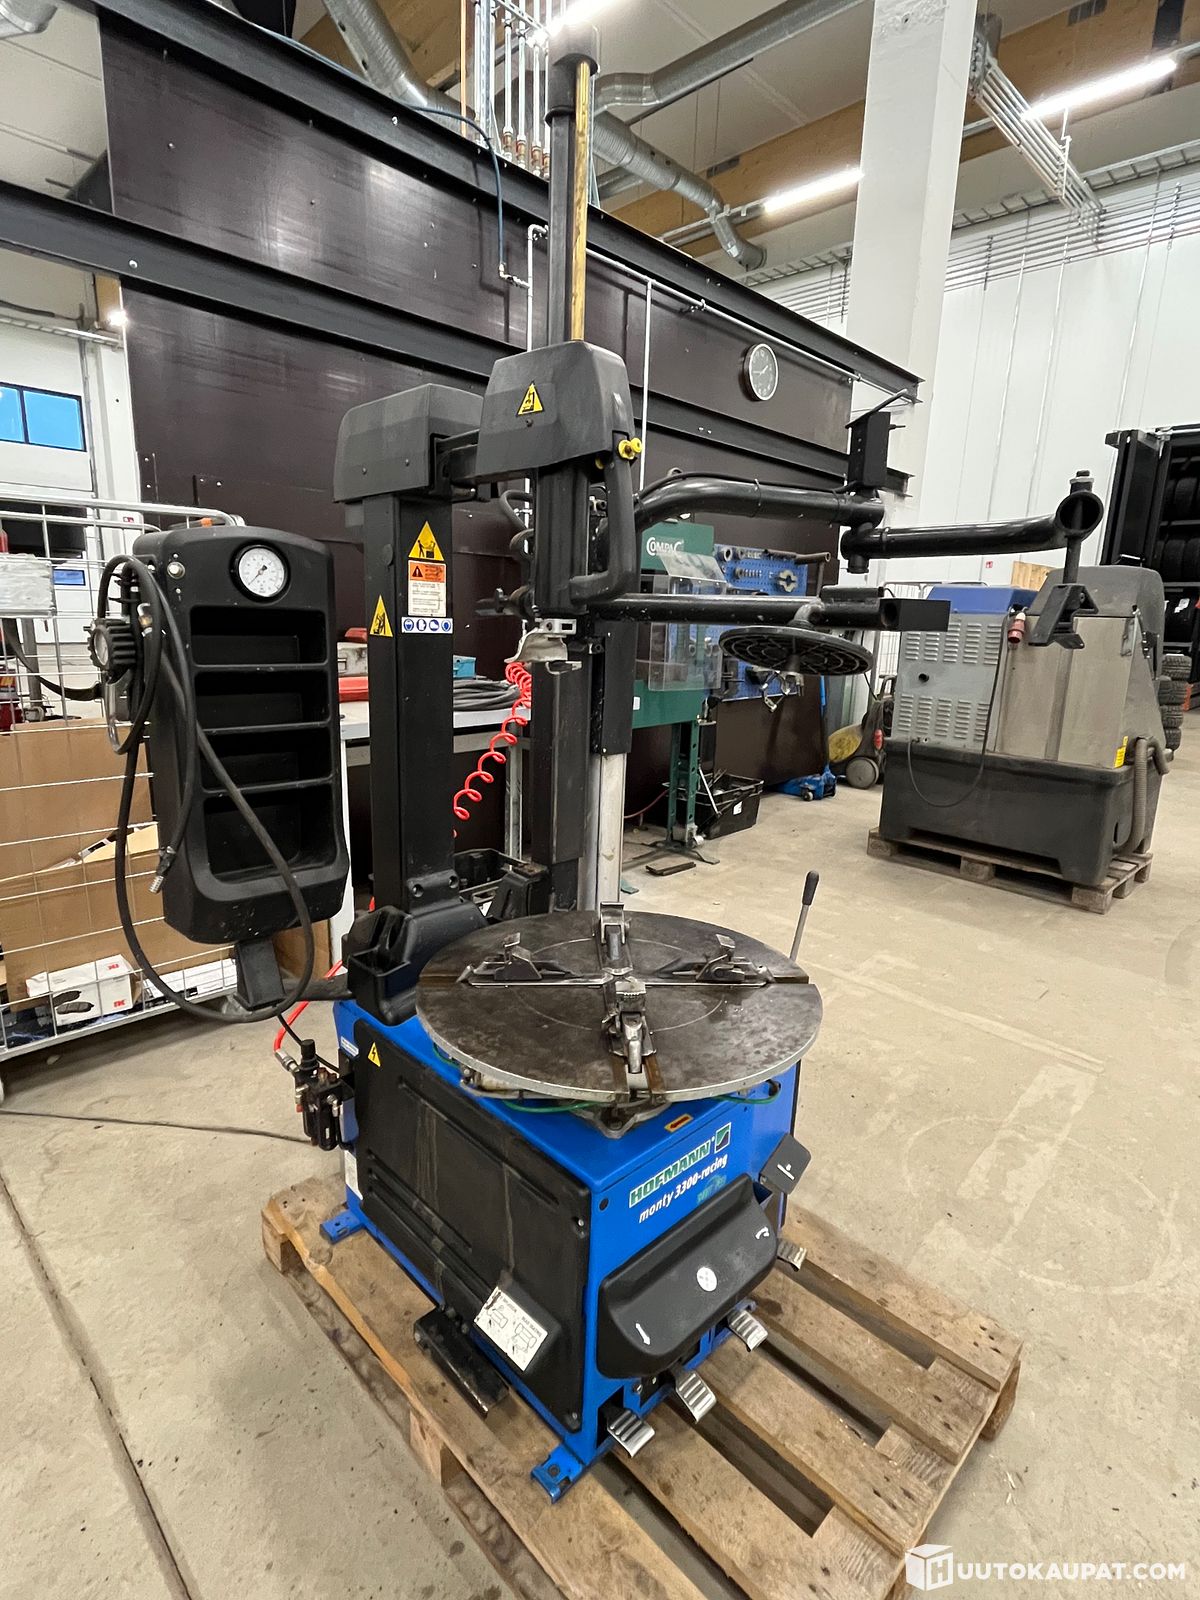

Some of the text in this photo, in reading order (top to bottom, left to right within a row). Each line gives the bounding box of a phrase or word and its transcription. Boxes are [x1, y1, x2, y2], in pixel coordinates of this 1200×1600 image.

[629, 1139, 712, 1209] HOFMANN
[639, 1191, 674, 1224] monty
[674, 1154, 728, 1200] 3300-racing
